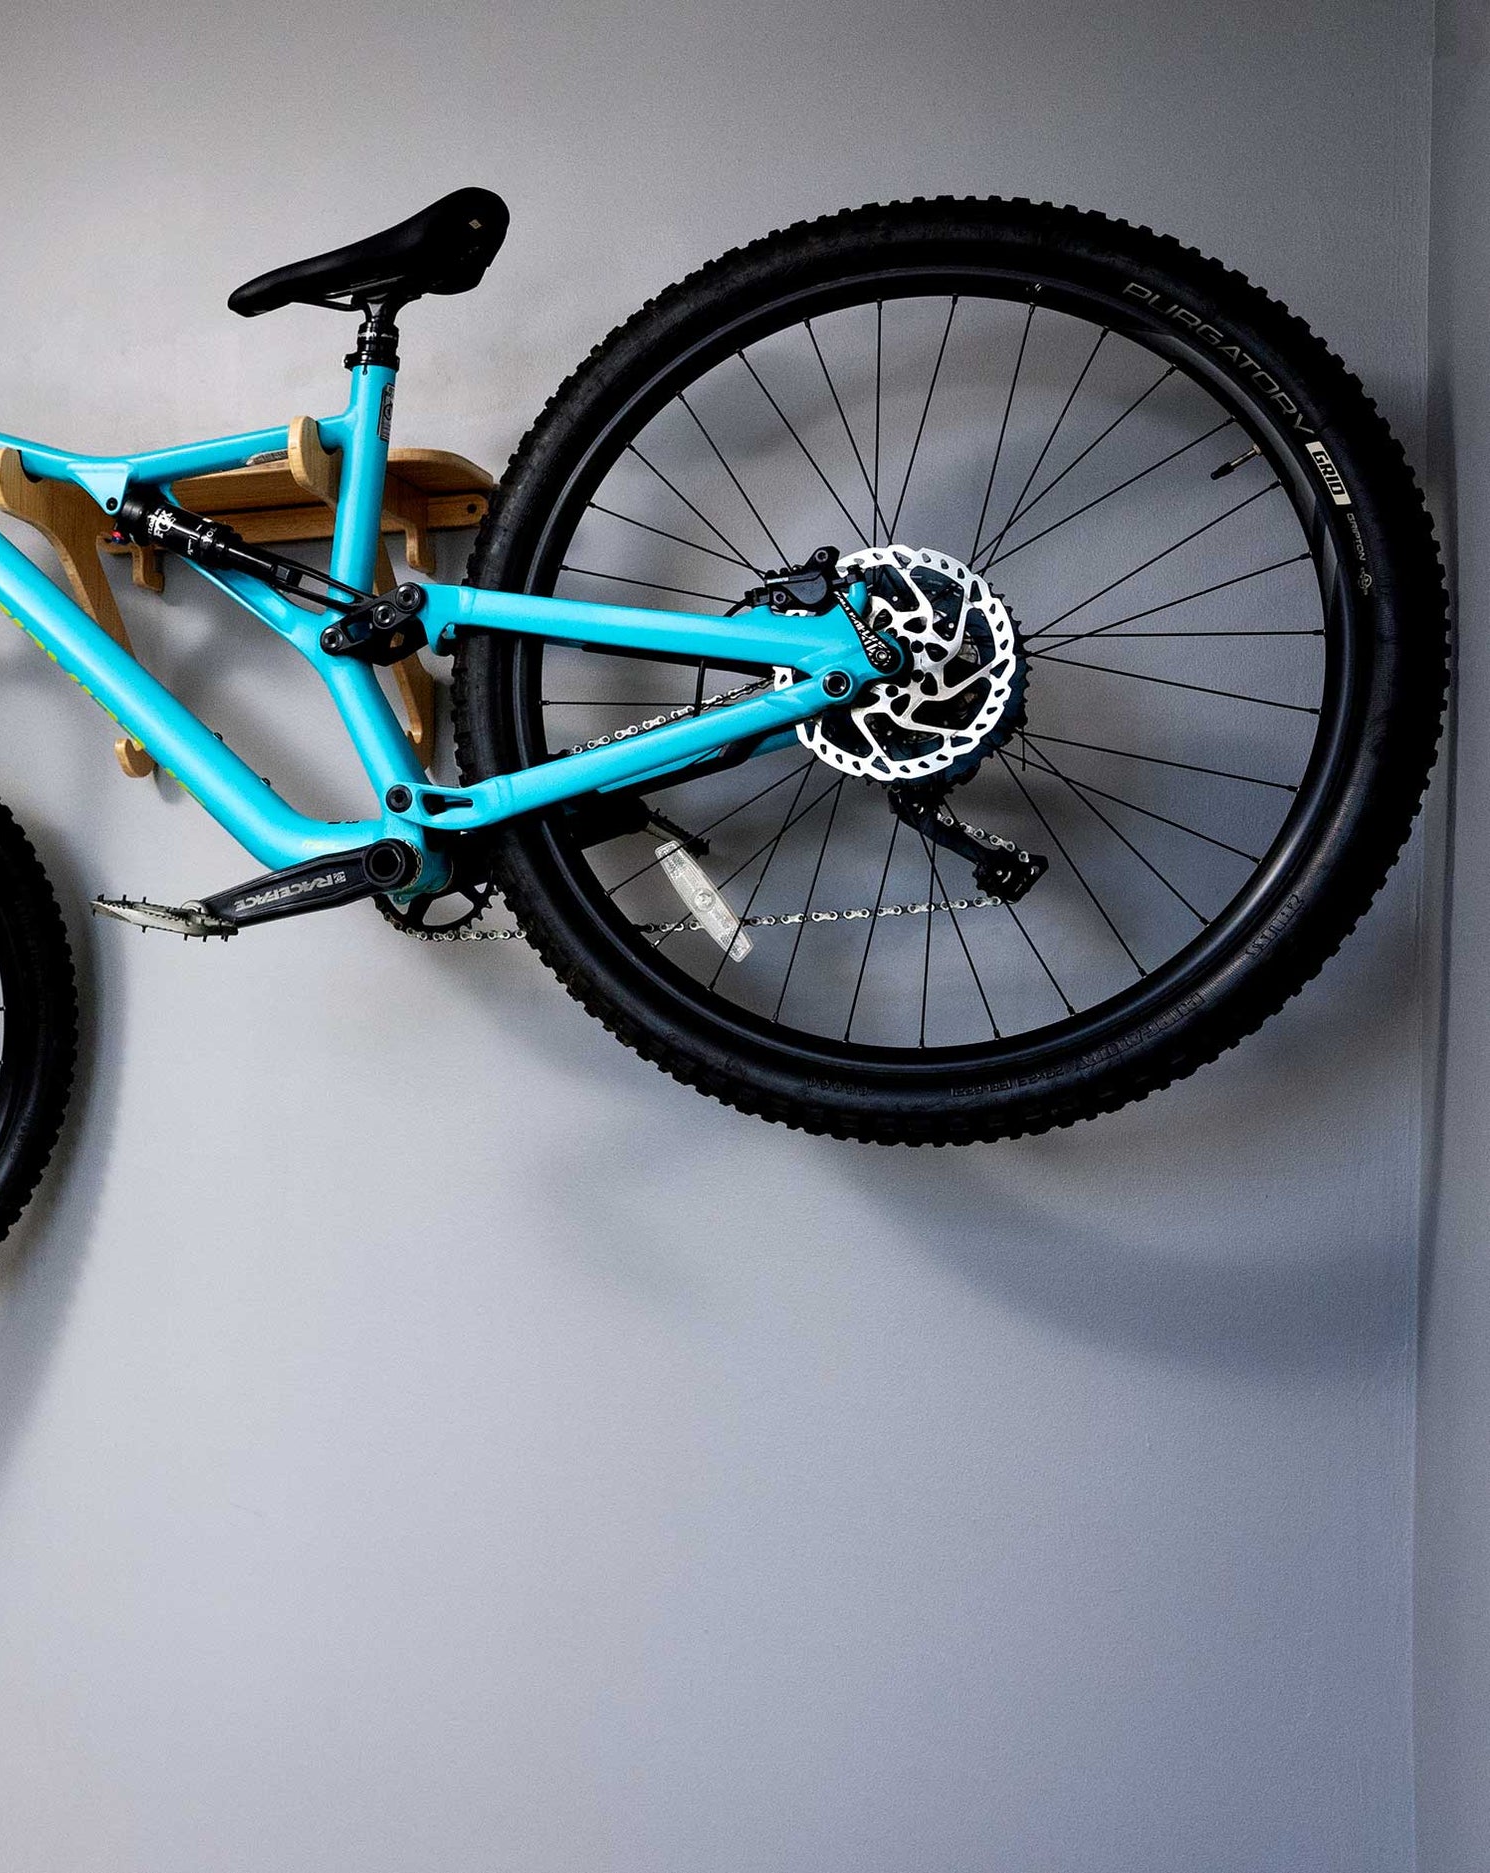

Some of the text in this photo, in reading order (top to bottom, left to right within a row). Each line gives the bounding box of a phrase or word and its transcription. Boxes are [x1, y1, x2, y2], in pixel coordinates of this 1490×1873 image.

[1121, 281, 1315, 435] PURGATORY
[1312, 450, 1349, 498] GRID
[233, 873, 334, 912] RACEFACE
